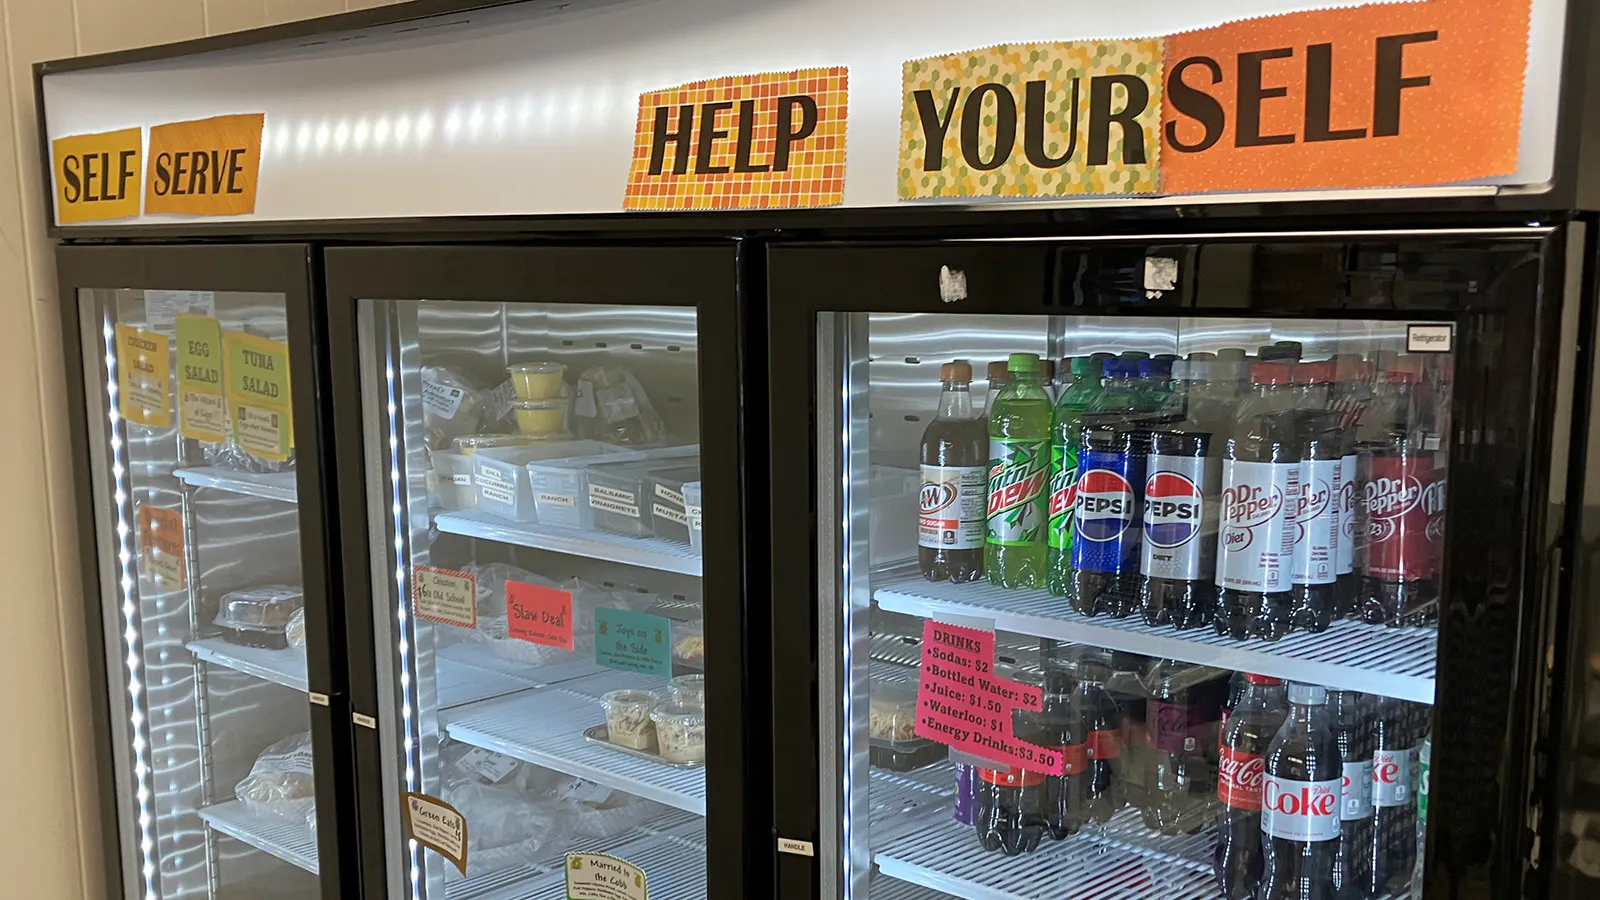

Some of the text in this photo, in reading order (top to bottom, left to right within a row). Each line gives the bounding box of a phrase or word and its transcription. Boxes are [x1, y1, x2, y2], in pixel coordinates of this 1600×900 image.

[648, 95, 818, 175] HELP
[63, 149, 246, 203] SELF SERVE
[188, 340, 210, 357] EGG
[242, 349, 274, 371] TUNA
[184, 364, 219, 383] SALAD
[242, 375, 279, 398] SALAD
[486, 470, 500, 478] DILL
[484, 489, 509, 501] RANCH
[593, 487, 633, 501] BALSAMIC
[660, 488, 683, 502] HONE
[1237, 484, 1262, 504] Dr
[1378, 478, 1402, 497] Dr
[541, 494, 568, 503] RANCH
[1076, 495, 1132, 514] PEPSI
[1222, 488, 1279, 523] Pepper
[1365, 482, 1417, 514] Pepper
[1144, 500, 1200, 519] PEPSI
[1225, 532, 1245, 545] Diet
[541, 610, 564, 628] Deal
[933, 629, 981, 653] DRINKS
[932, 647, 988, 673] Sodas: $2
[932, 664, 1037, 707] Bottled Water: $2
[930, 682, 1002, 714] Juice: $1.50
[929, 699, 1003, 733] Waterloo: $1
[927, 717, 970, 741] Energy
[1264, 780, 1335, 816] Coke
[419, 806, 440, 822] Green
[590, 859, 621, 874] Married
[610, 876, 628, 890] Cobb
